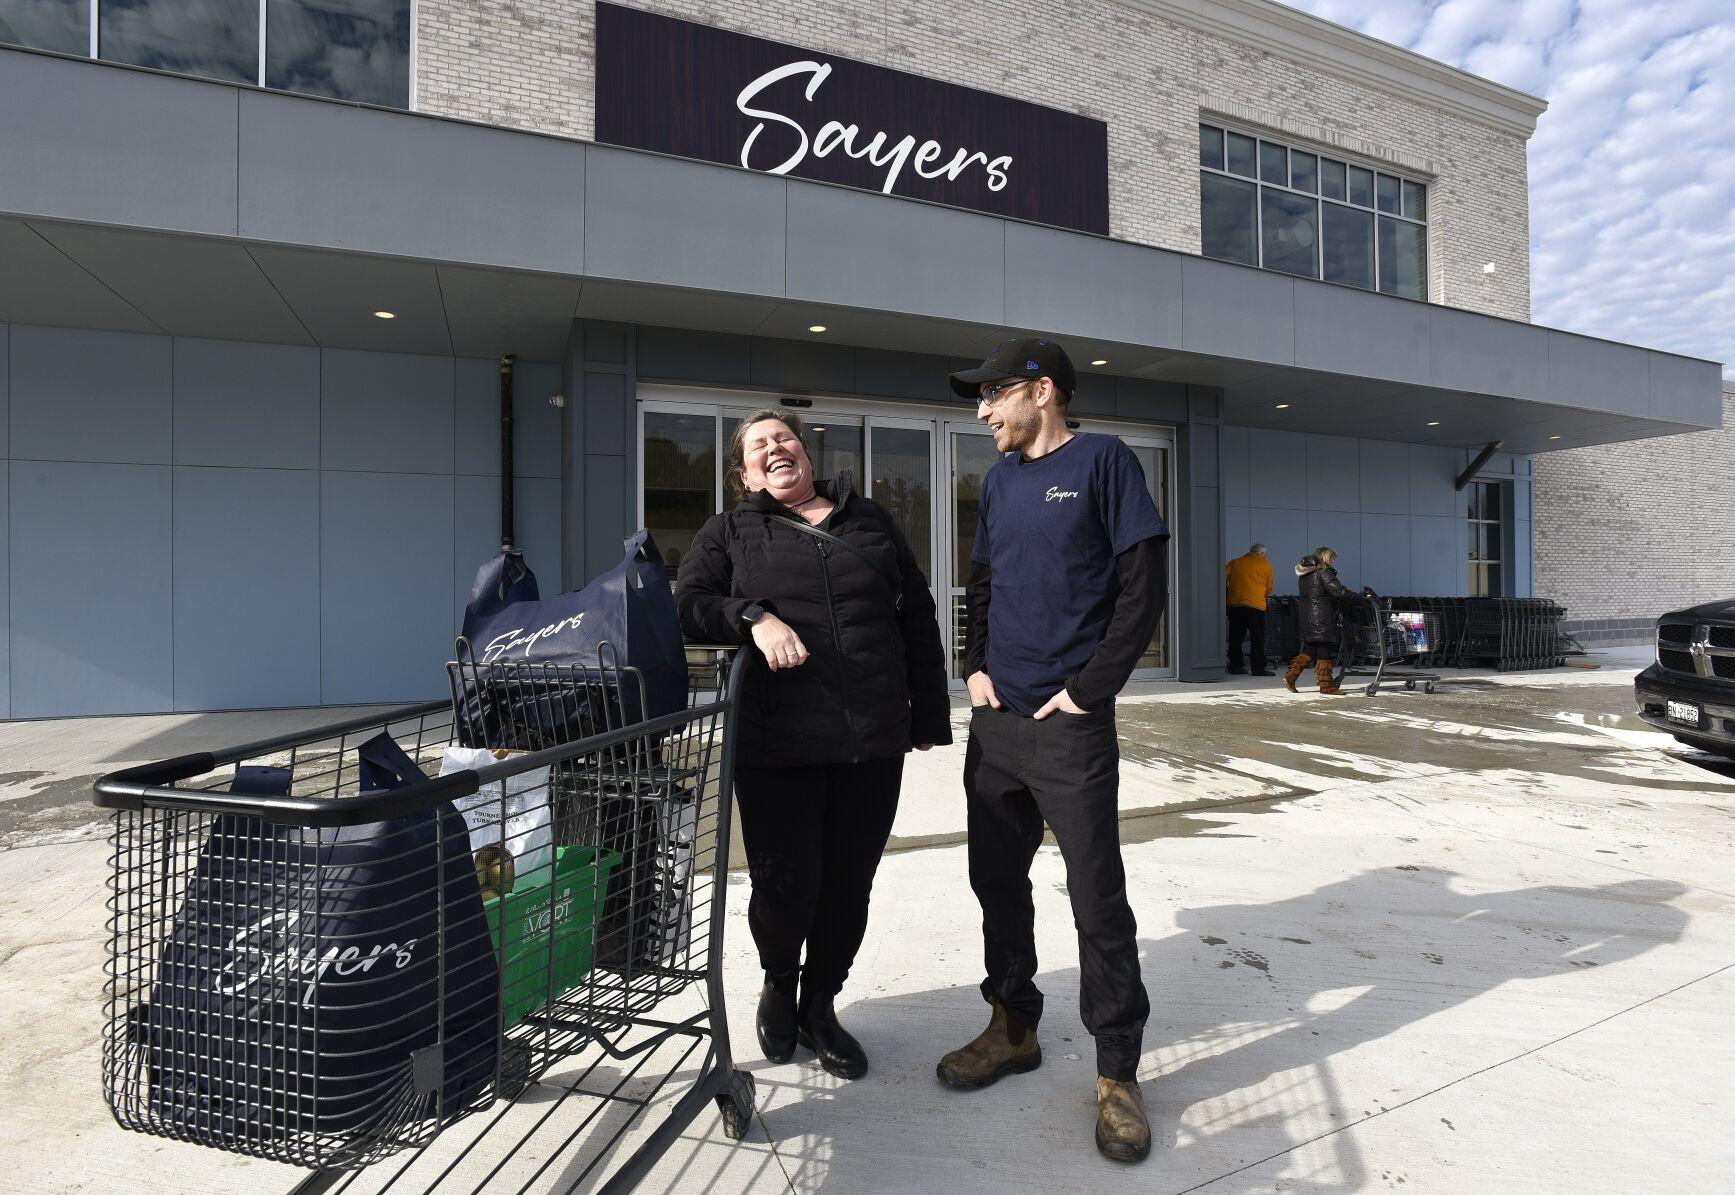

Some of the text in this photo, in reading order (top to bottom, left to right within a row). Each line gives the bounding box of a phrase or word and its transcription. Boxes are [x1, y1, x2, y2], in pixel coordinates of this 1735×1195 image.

[736, 60, 1013, 194] Sayers
[1045, 486, 1079, 503] Sayers
[482, 612, 584, 663] Sayers
[215, 910, 419, 1010] Sayers
